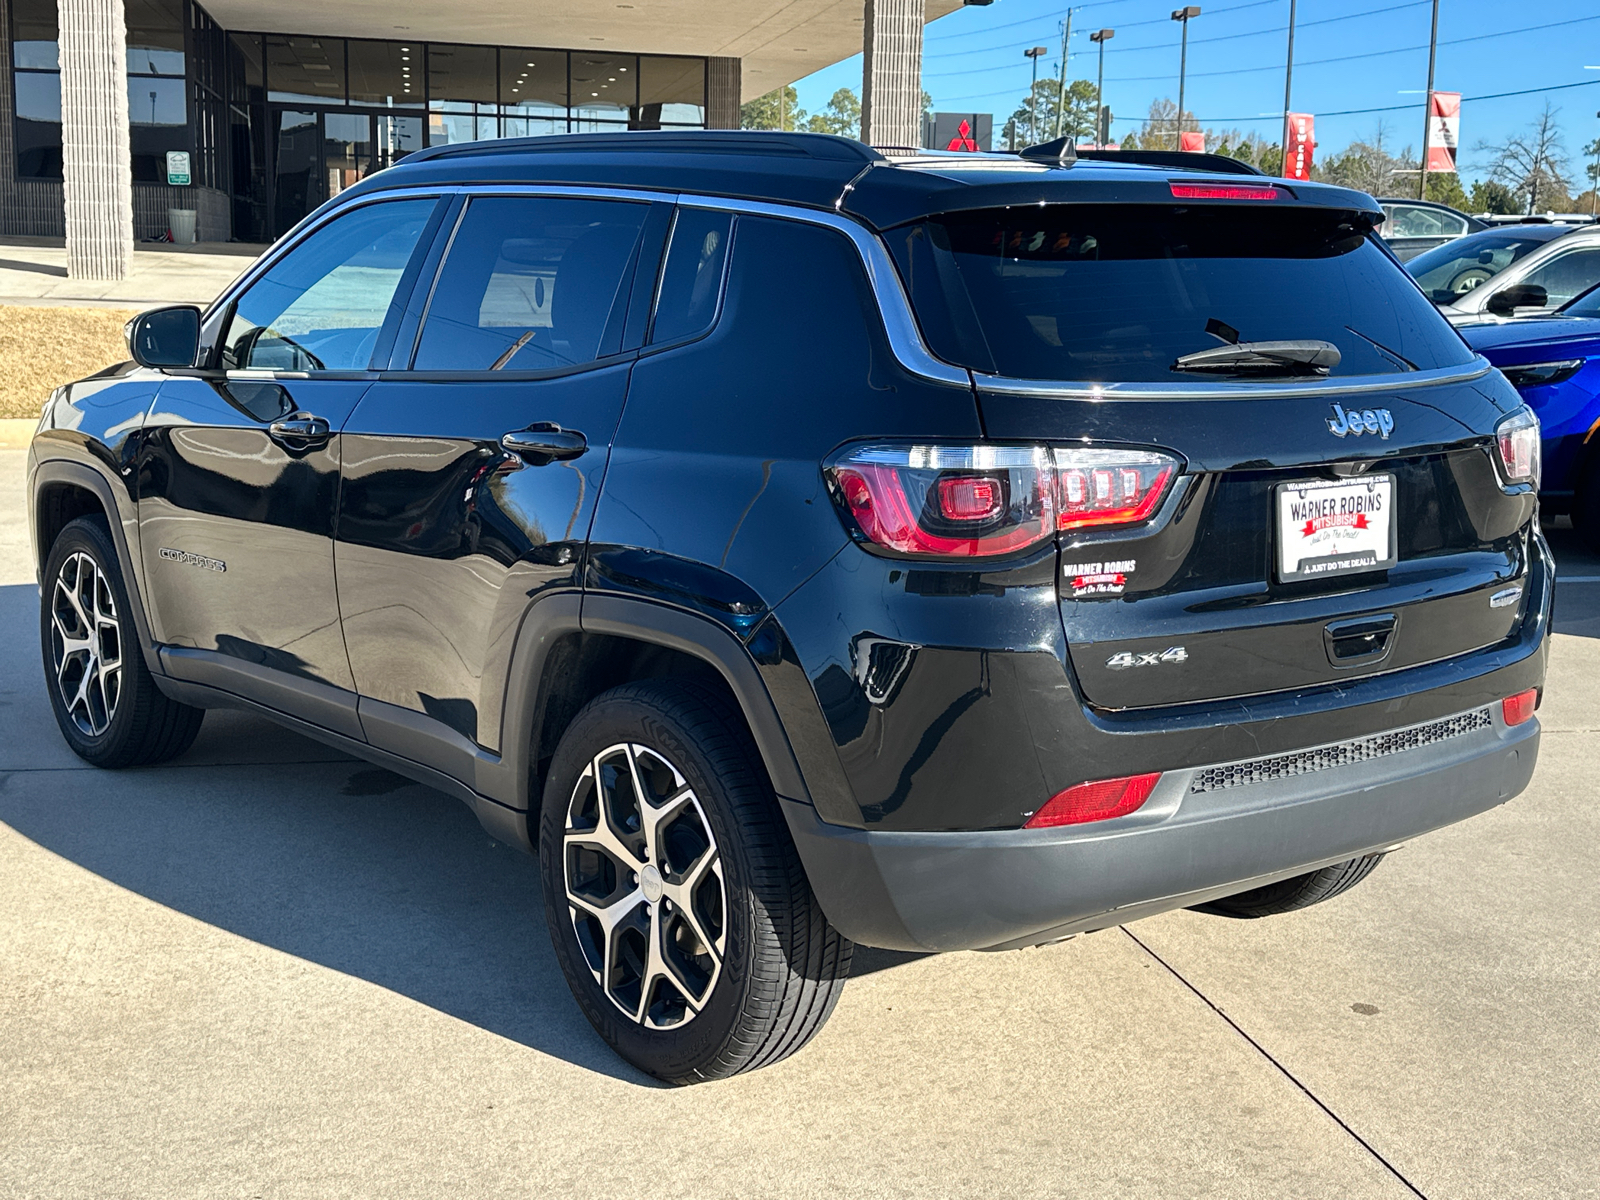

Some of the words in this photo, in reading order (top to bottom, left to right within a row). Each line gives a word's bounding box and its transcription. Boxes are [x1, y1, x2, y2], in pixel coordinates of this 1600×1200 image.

[1325, 402, 1395, 440] Jeep
[1290, 498, 1336, 521] WARNER
[1341, 493, 1382, 514] ROBINS
[1312, 514, 1358, 531] MITSUBISHI
[1323, 530, 1331, 541] Do
[1332, 529, 1342, 539] The
[159, 547, 227, 572] COMPASS
[1311, 563, 1326, 573] JUST
[1327, 562, 1337, 571] DO
[1338, 560, 1350, 569] THE
[1351, 557, 1370, 568] DEAL!
[1063, 563, 1102, 577] WARNER
[1104, 560, 1136, 573] ROBINS
[1082, 574, 1117, 584] MITSUBISHI
[1087, 585, 1096, 593] Do
[1096, 583, 1107, 592] The
[1105, 646, 1189, 671] 4x4
[659, 731, 743, 953] MASTERCRAFT
